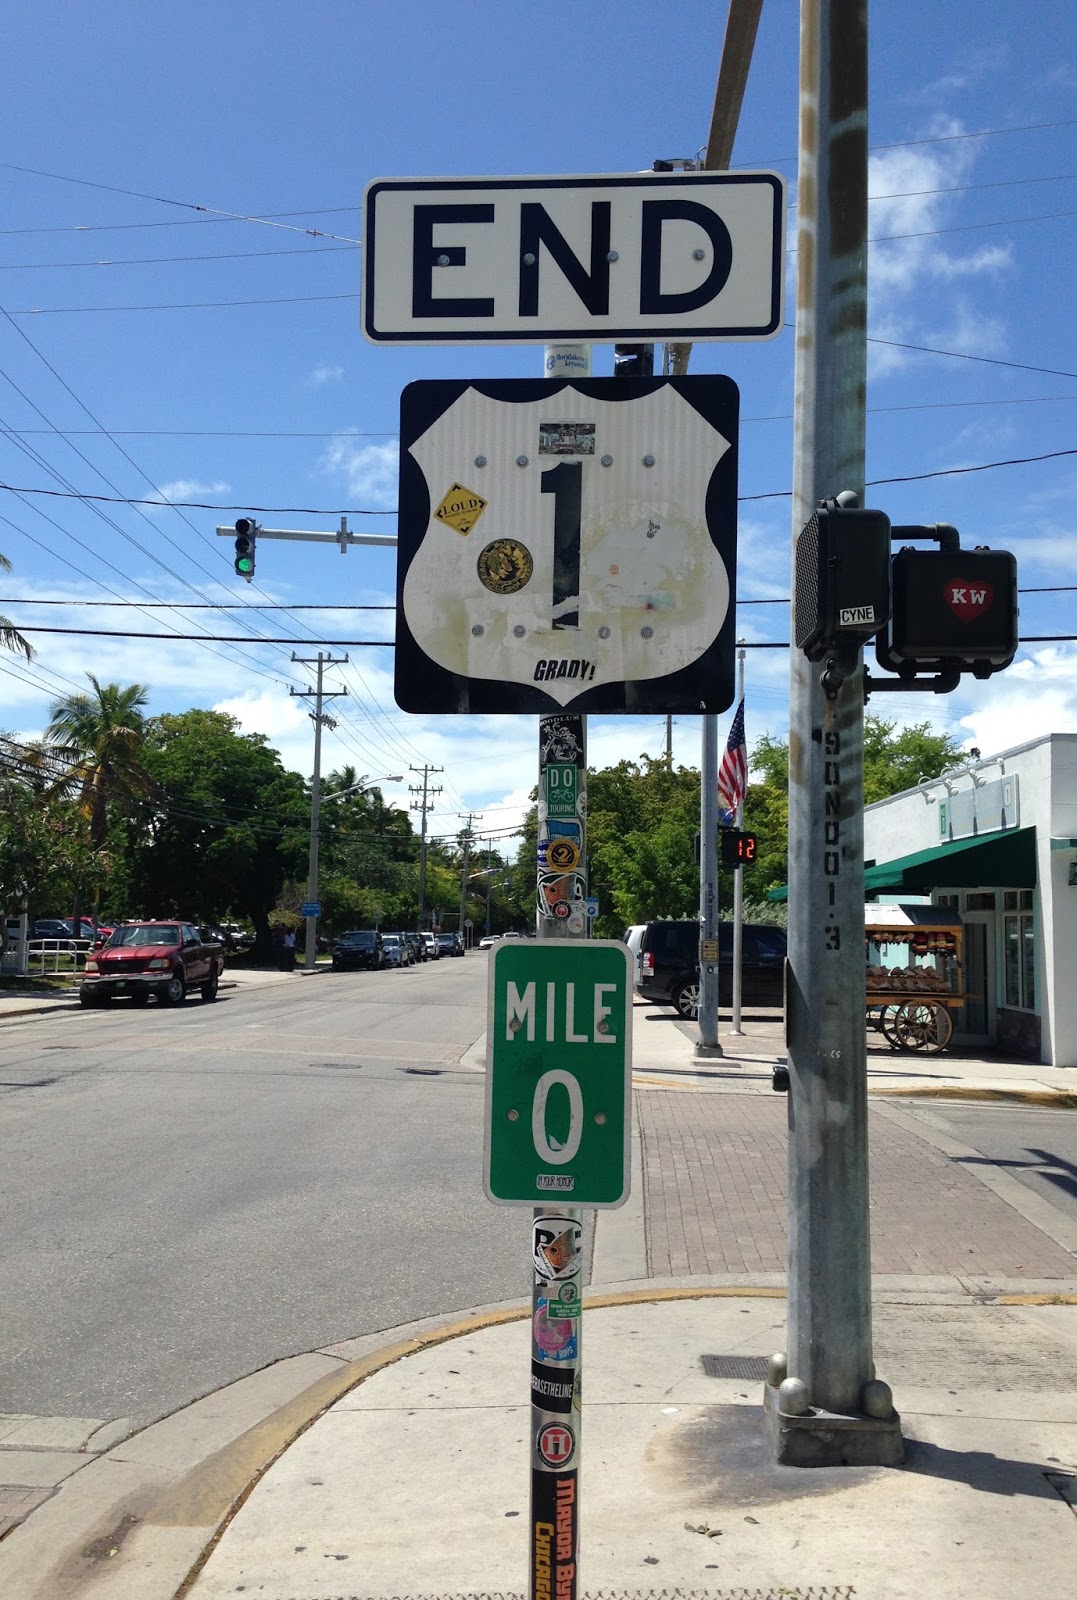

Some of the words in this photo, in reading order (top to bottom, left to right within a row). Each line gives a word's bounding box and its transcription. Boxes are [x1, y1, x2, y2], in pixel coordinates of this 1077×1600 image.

[412, 199, 733, 318] END
[442, 499, 478, 515] LOUD
[540, 461, 583, 630] 1
[951, 588, 987, 605] KW
[842, 606, 873, 623] CYNE
[533, 659, 596, 682] GRADY!
[550, 803, 575, 813] TOURING
[738, 839, 755, 858] 12
[505, 981, 617, 1044] MILE
[531, 1069, 584, 1165] 0
[556, 1478, 575, 1560] MAYOR
